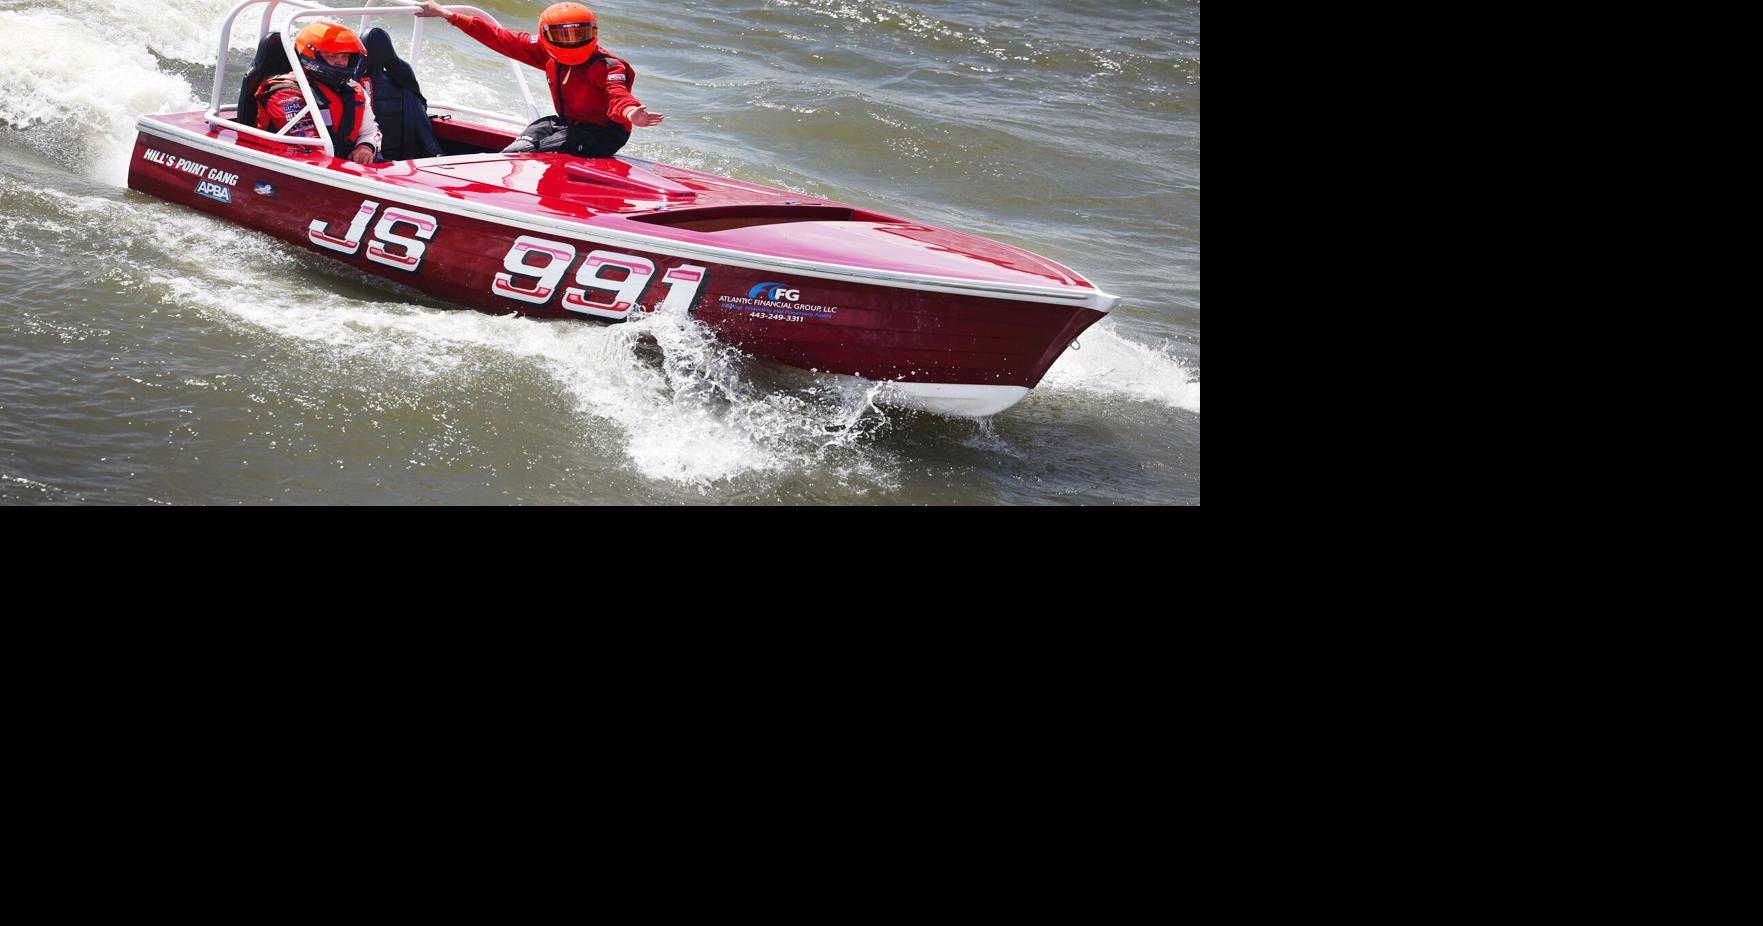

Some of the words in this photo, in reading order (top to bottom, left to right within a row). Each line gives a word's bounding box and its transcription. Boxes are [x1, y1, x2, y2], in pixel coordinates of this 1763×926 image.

[143, 148, 176, 166] HILL'S
[175, 158, 209, 177] POINT
[207, 168, 239, 186] GANG
[197, 181, 230, 200] APBA
[308, 199, 438, 272] JS
[491, 235, 707, 319] 991
[718, 295, 753, 305] ATLANTIC
[753, 299, 792, 309] FINANCIAL
[793, 303, 822, 313] GROUP,
[749, 311, 804, 322] 443-249-3311
